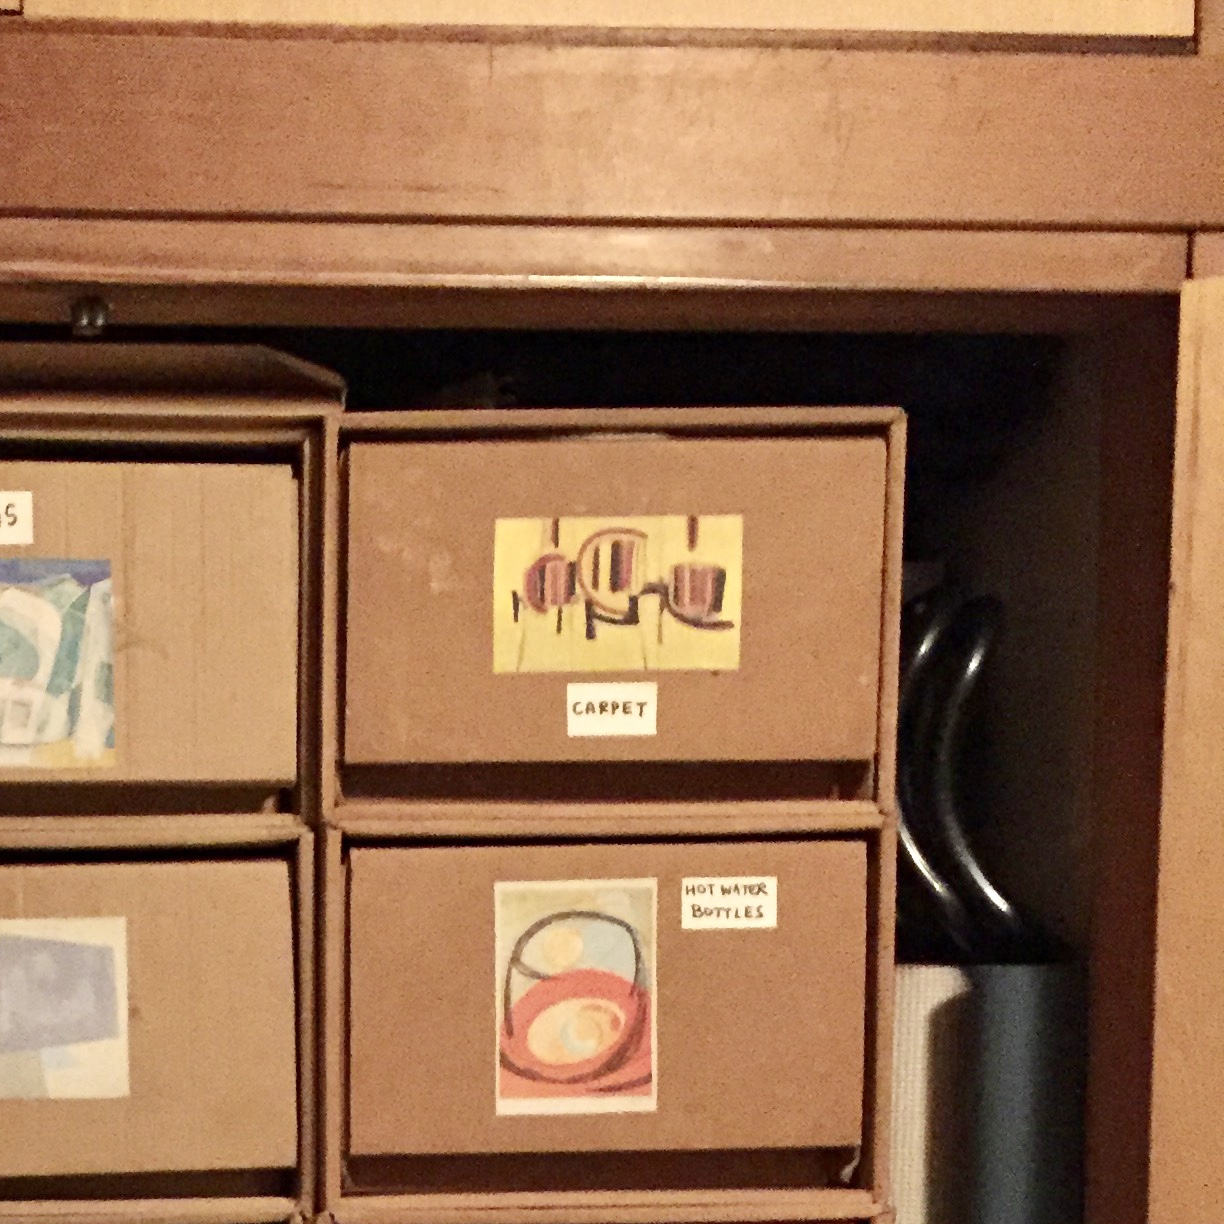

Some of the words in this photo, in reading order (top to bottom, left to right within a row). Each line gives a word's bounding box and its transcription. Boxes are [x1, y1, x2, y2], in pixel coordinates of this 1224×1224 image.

[570, 701, 648, 718] CARPET
[684, 883, 715, 897] HOT
[719, 882, 767, 898] WATER
[691, 903, 763, 919] BOTTLES
